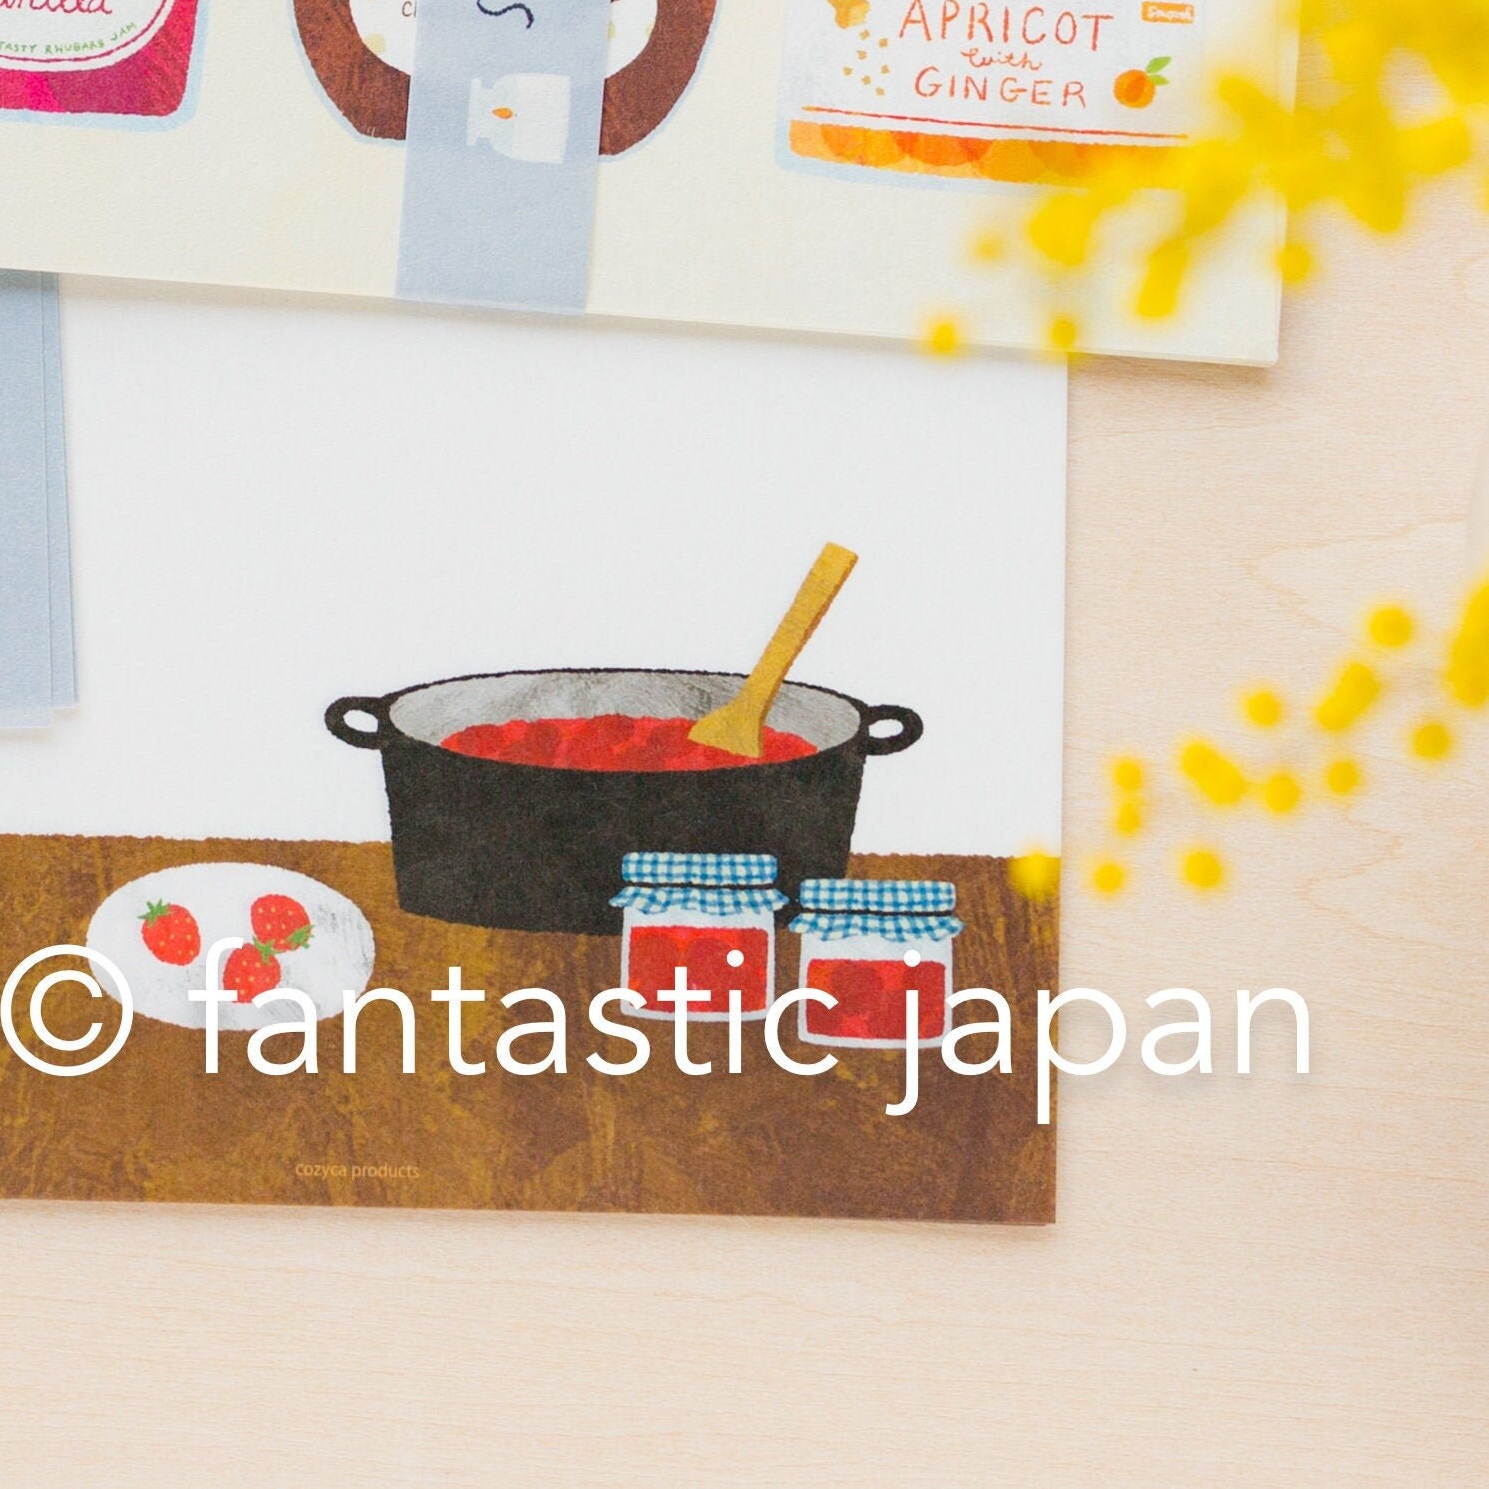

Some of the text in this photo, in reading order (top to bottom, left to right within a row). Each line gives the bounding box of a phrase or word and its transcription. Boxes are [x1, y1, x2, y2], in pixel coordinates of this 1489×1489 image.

[44, 38, 105, 54] RHUBARB
[111, 22, 138, 41] JAM
[960, 47, 1042, 71] with
[913, 66, 1086, 109] GINGER
[295, 1163, 420, 1181] cozyca products
